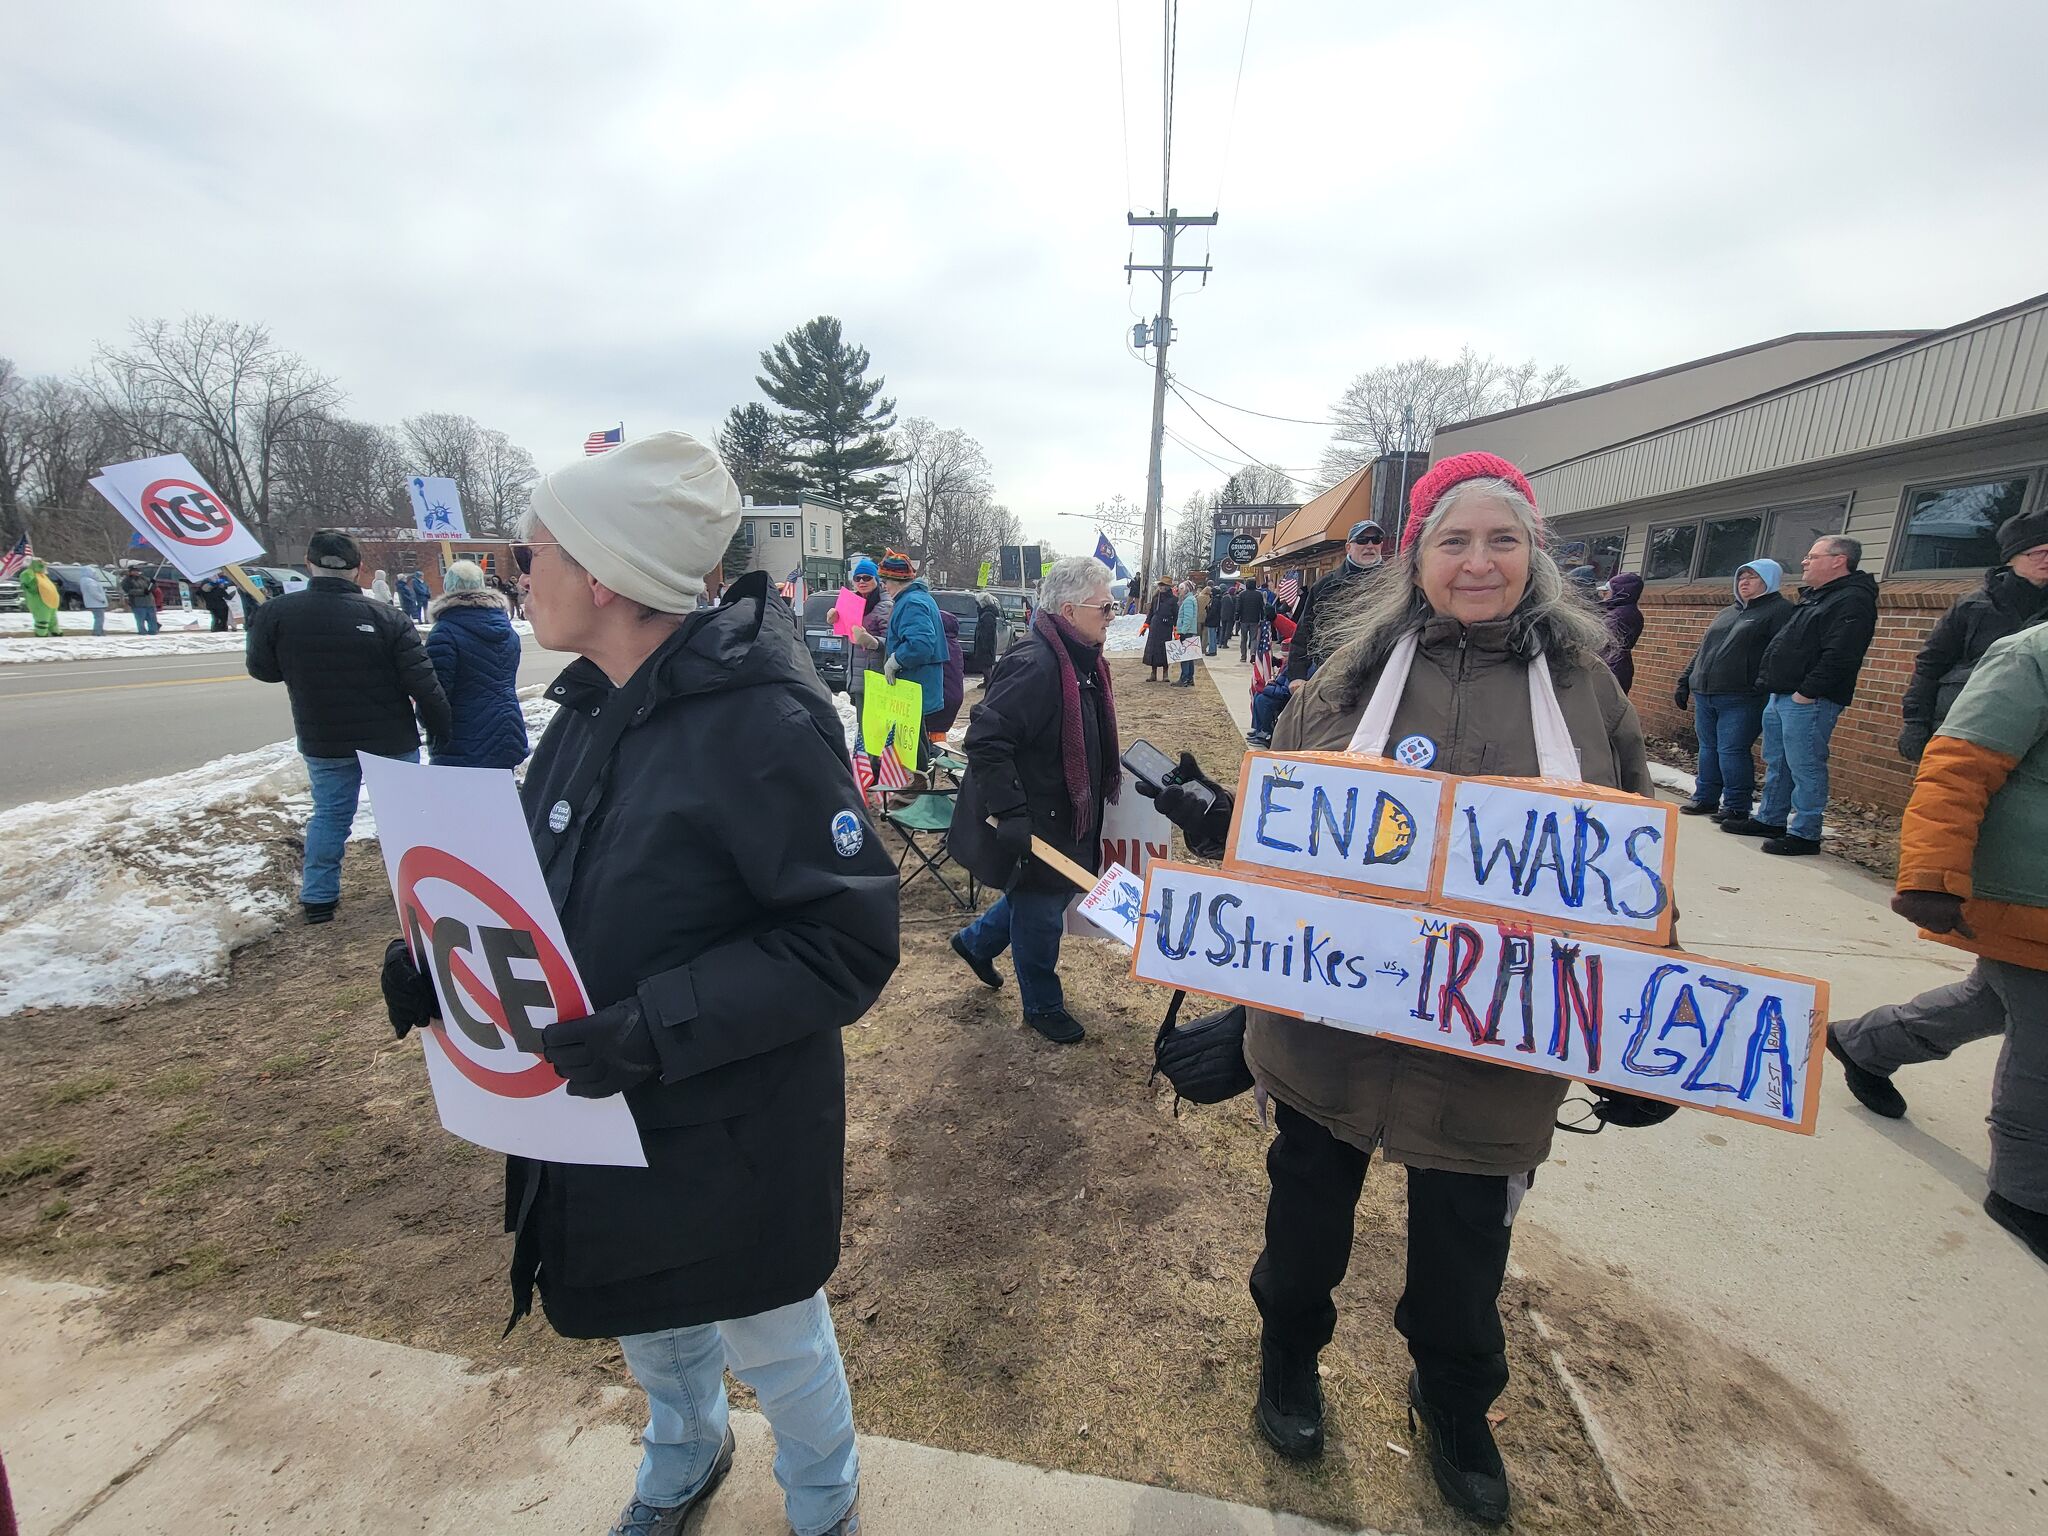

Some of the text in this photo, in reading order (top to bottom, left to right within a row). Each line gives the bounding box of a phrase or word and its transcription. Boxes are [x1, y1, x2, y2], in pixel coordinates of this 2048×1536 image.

[149, 491, 230, 539] ICE
[434, 531, 449, 539] with
[1231, 514, 1270, 527] COFFEE
[889, 700, 910, 718] PEOPLE
[1256, 774, 1668, 919] END WARS
[1389, 806, 1411, 842] ICE
[1084, 866, 1123, 909] I'm with Her
[404, 904, 554, 1053] ICE
[1409, 922, 1604, 1073] IRAN
[1621, 964, 1793, 1119] GAZA
[1764, 1062, 1782, 1110] WEST
